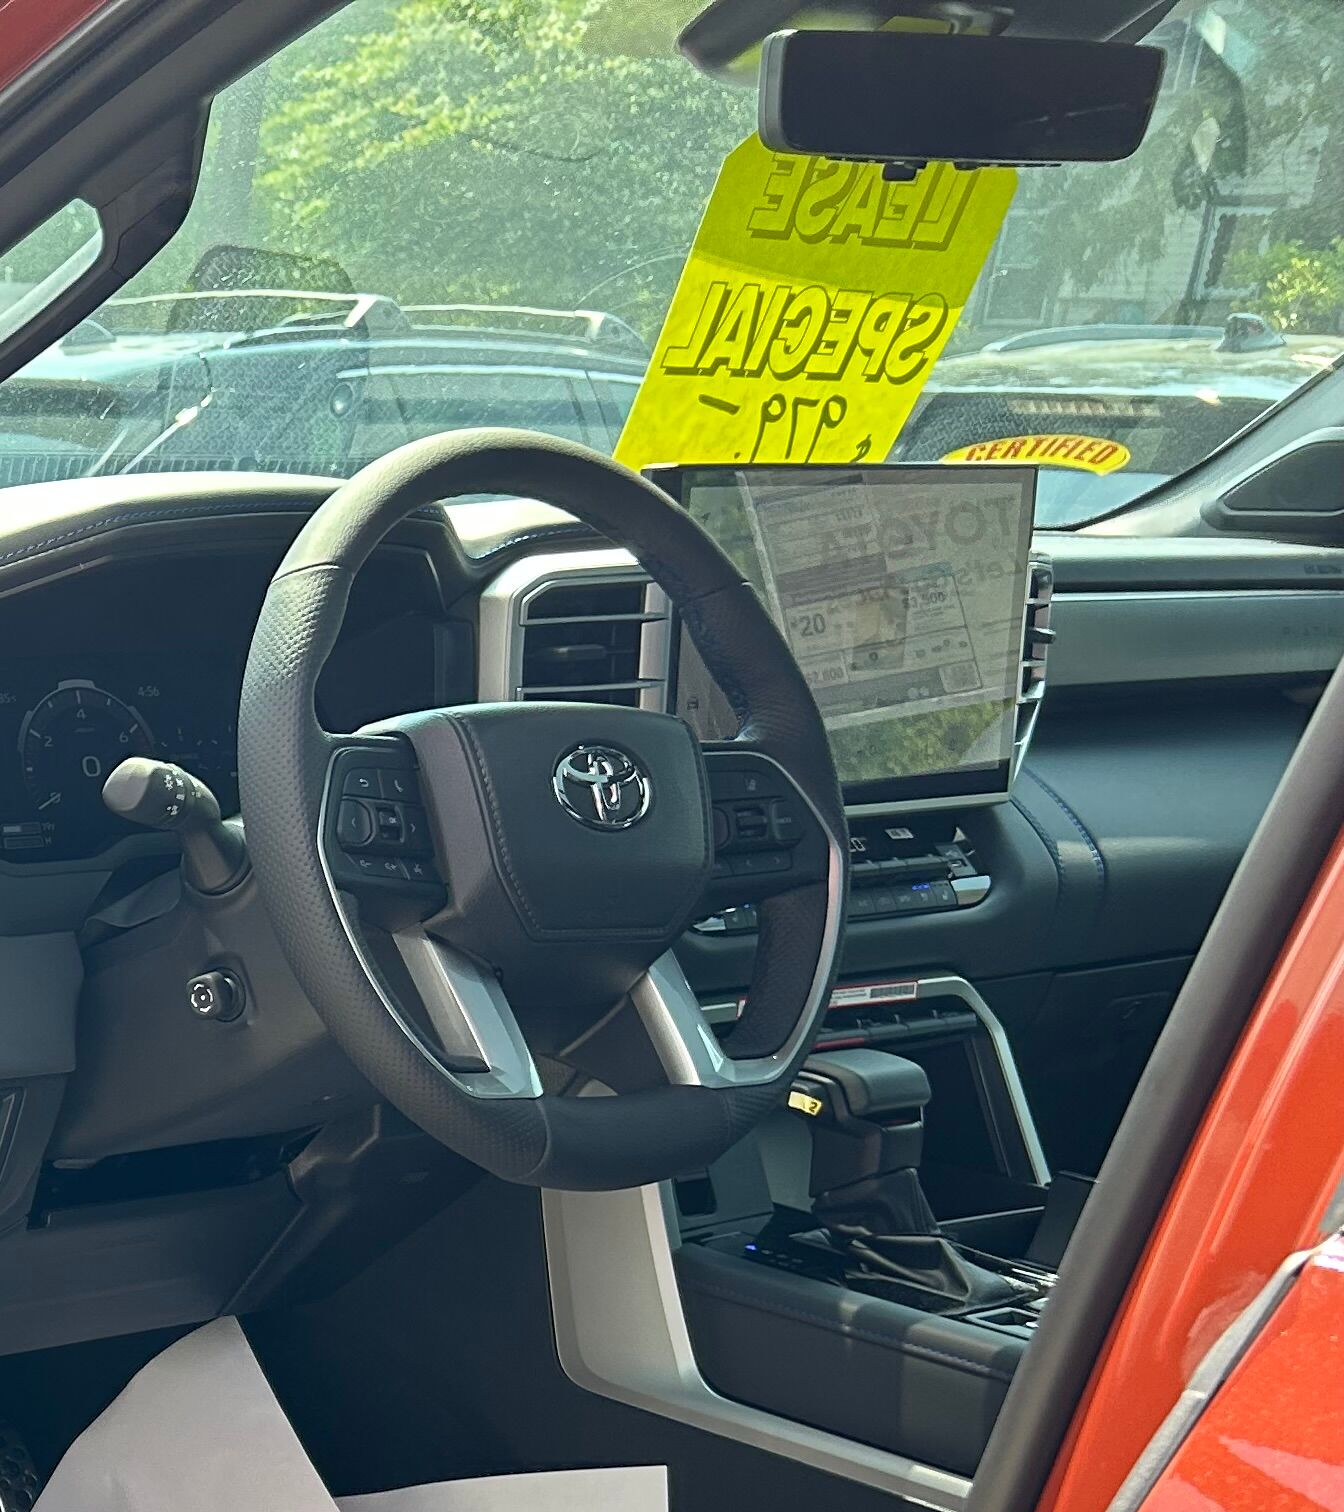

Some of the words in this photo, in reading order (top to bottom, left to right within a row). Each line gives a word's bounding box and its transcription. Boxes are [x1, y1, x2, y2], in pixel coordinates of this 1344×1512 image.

[965, 436, 1120, 465] CERTIFIED
[76, 708, 86, 719] 4
[45, 736, 54, 748] 2
[119, 732, 129, 743] 6
[82, 756, 101, 777] 0
